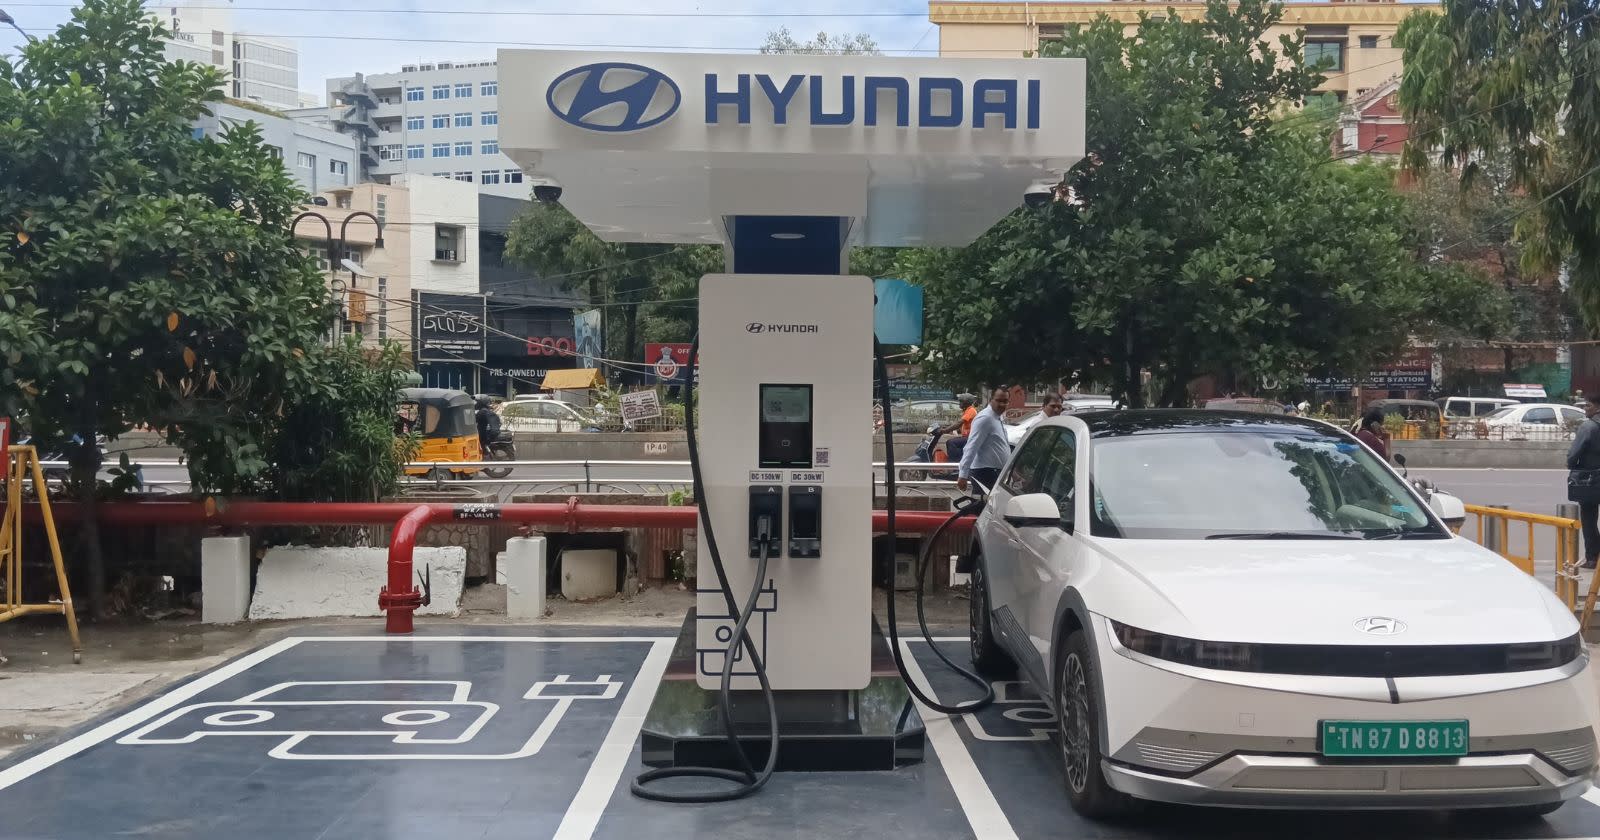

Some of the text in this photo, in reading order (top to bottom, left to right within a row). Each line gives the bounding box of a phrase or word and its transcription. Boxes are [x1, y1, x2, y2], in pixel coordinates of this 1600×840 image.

[705, 74, 1040, 129] HYUNDAI
[768, 324, 818, 333] HYUNDAI
[508, 368, 535, 377] OWNED
[803, 473, 822, 481] 30kW
[1339, 727, 1464, 749] TN 87 D 8813
